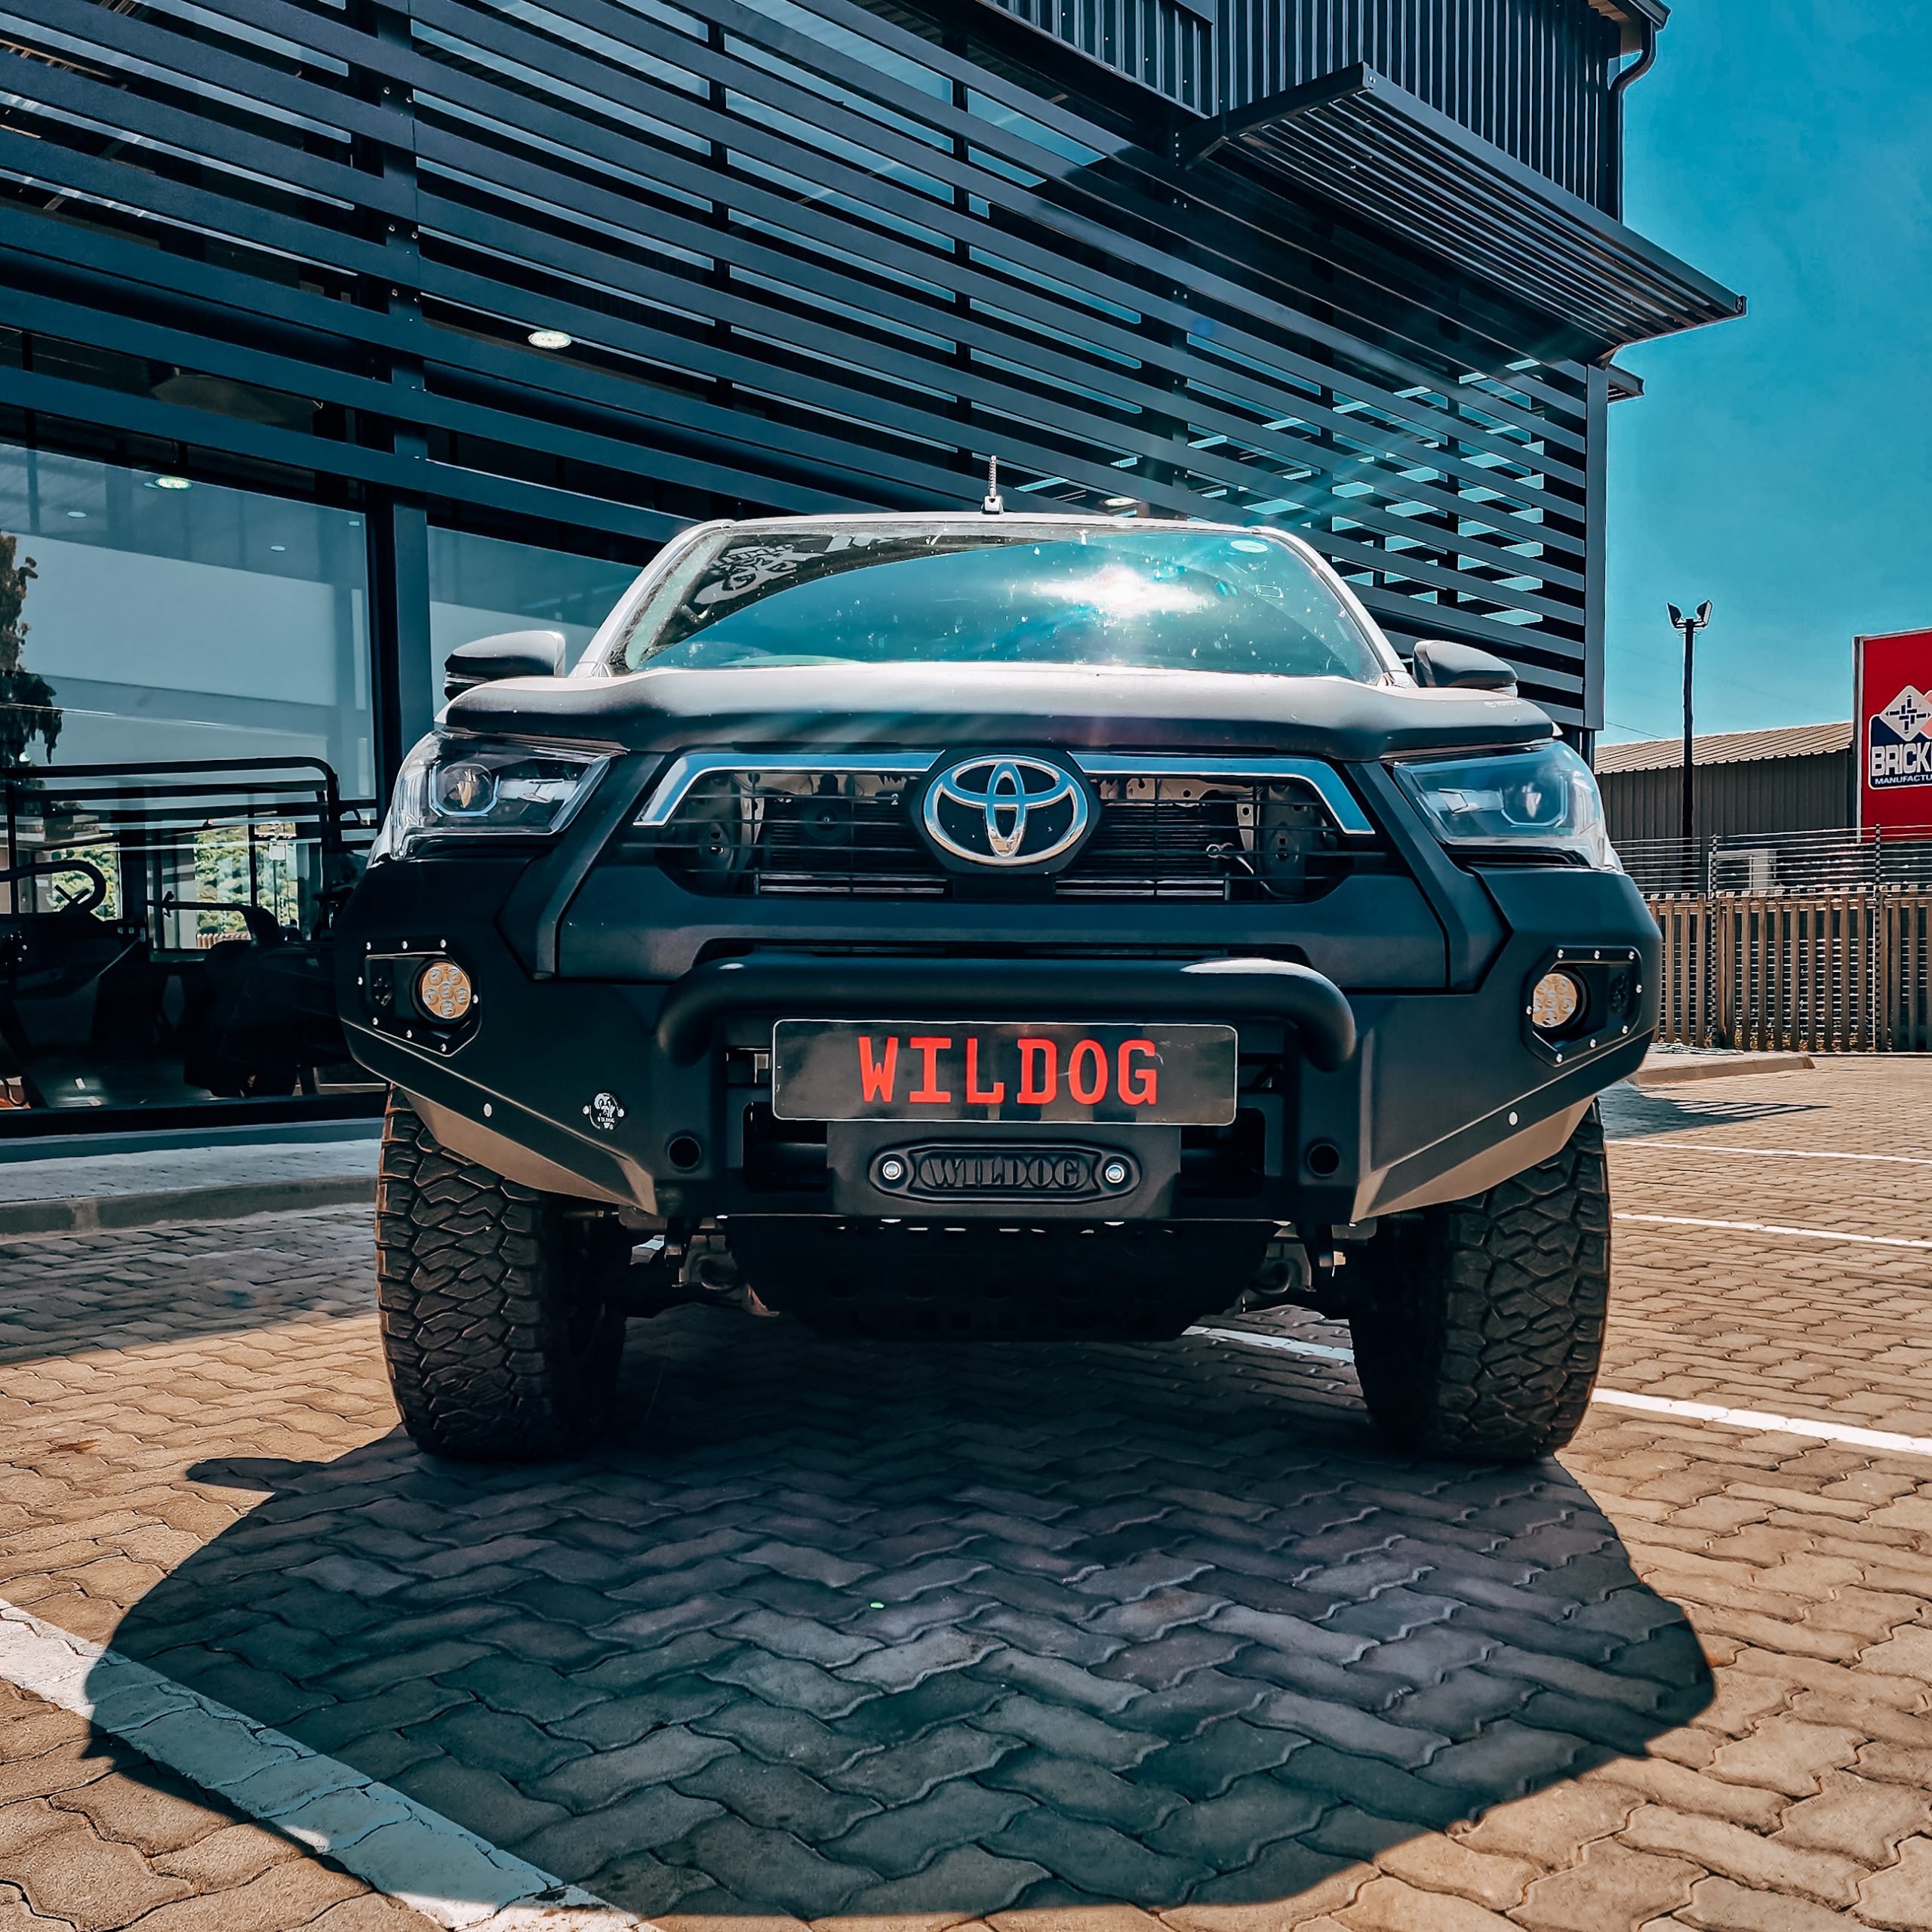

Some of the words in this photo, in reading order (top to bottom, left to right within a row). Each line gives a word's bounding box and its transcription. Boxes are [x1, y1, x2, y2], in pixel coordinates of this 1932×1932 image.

[1872, 741, 1932, 776] BRICK
[857, 1036, 1158, 1105] WILDOG
[922, 1157, 1082, 1187] WILDOG
